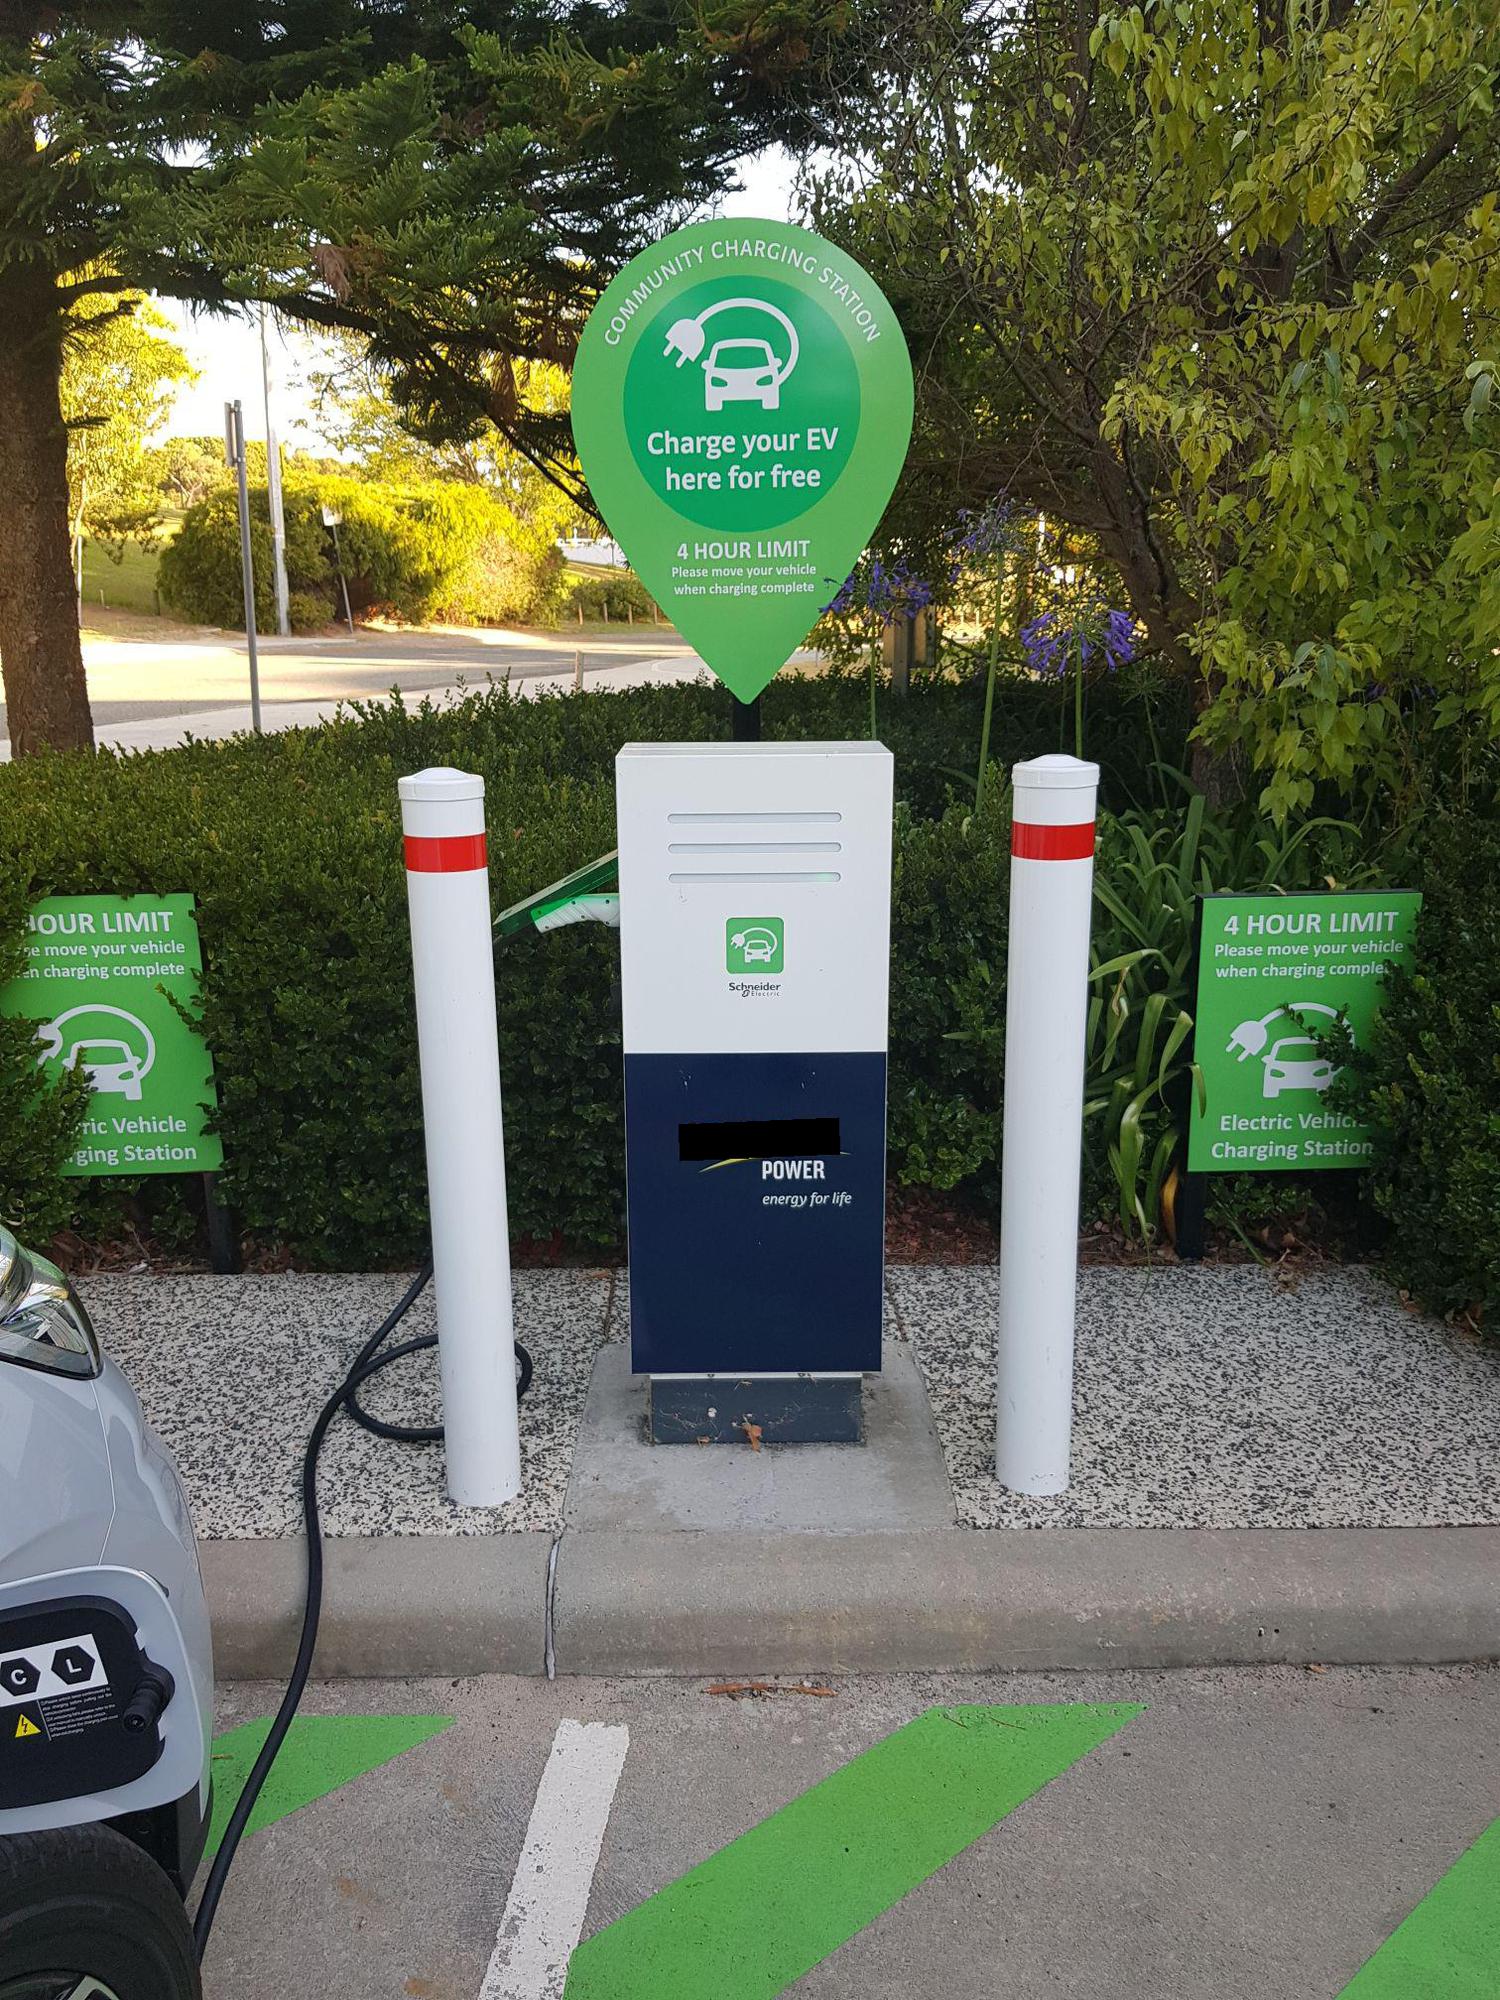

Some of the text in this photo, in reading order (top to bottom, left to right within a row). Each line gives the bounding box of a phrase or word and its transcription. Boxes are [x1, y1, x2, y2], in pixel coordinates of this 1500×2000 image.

[604, 239, 881, 346] COMMUNITY CHARGING STATION
[647, 427, 839, 460] Charge your EV
[666, 463, 821, 491] here for free
[677, 540, 811, 560] 4 HOUR LIMIT
[672, 563, 817, 579] Please move your vehicle
[674, 581, 815, 596] when charging complete
[102, 911, 174, 933] LIMIT
[1223, 911, 1399, 936] 4 HOUR LIMIT
[44, 944, 88, 956] move
[91, 942, 127, 959] your
[130, 940, 185, 954] vehicle
[1215, 939, 1404, 957] Please move your vehicle
[44, 963, 109, 980] charging
[113, 962, 185, 979] complete
[1216, 961, 1385, 979] when charging comple
[728, 982, 781, 992] Schneider
[112, 1116, 187, 1134] Vehicle
[1220, 1114, 1292, 1132] Electric
[124, 1143, 197, 1162] Station
[1211, 1139, 1373, 1161] Charging Station
[761, 1160, 826, 1180] POWER
[762, 1191, 852, 1208] energy for life
[10, 1658, 82, 1685] C L
